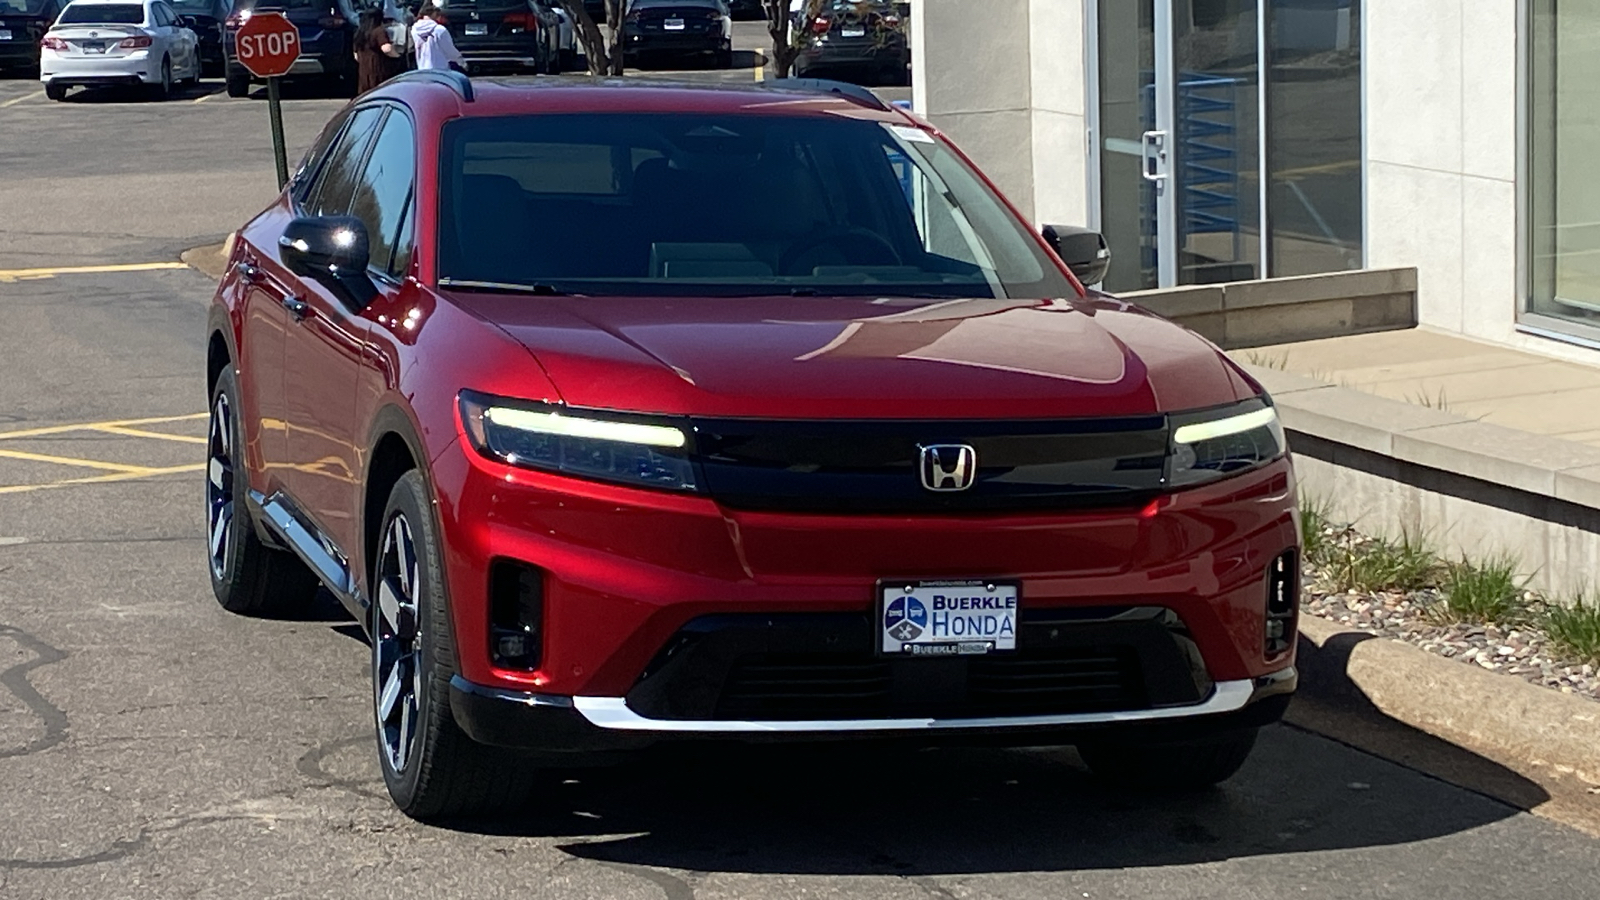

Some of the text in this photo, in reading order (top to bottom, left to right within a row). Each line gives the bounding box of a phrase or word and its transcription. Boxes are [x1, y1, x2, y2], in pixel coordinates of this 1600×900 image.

[240, 31, 296, 59] STOP
[932, 595, 1016, 610] BUERKLE
[932, 611, 1014, 637] HONDA
[912, 644, 958, 655] BUERKLE
